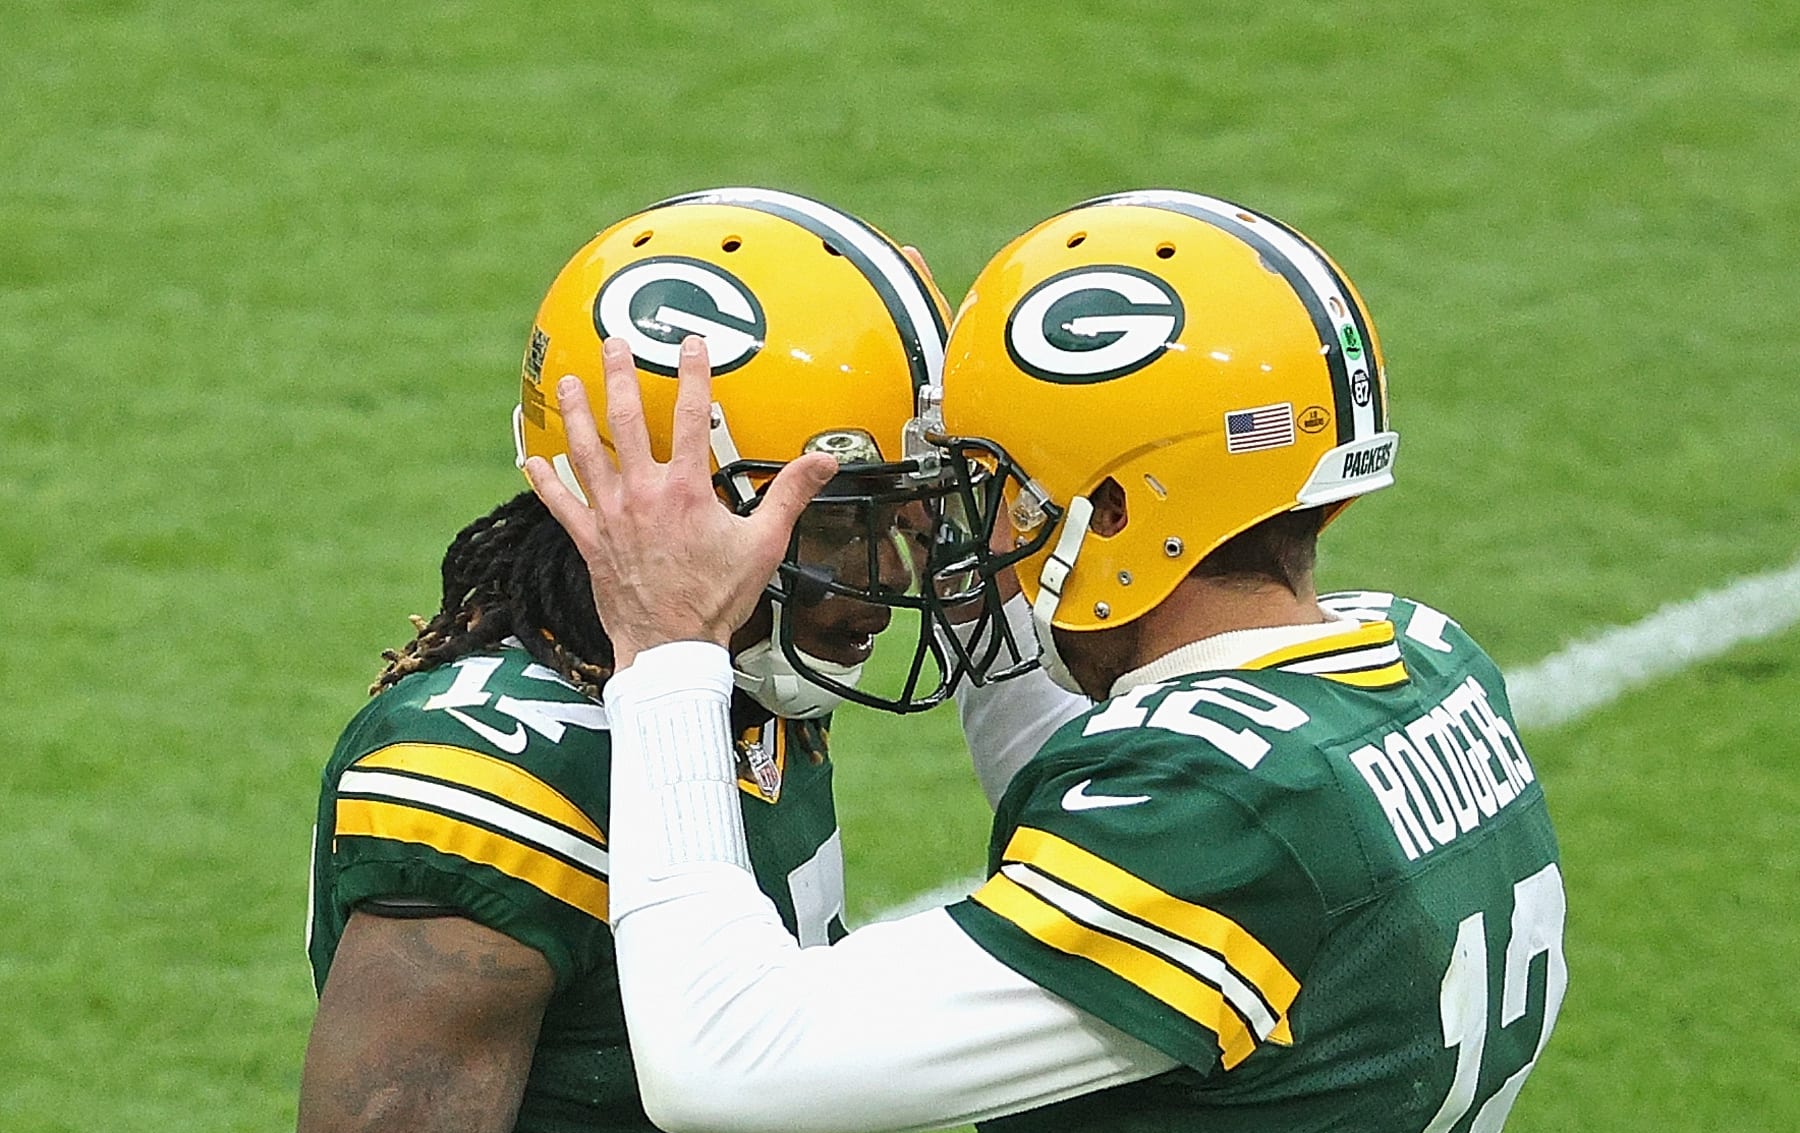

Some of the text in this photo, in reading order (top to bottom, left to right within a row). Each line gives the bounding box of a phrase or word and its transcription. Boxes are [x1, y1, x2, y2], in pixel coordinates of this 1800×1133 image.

[1011, 272, 1176, 375] G
[1354, 380, 1369, 403] 87
[1342, 441, 1393, 479] PACKERS
[1082, 676, 1311, 770] 12
[1348, 674, 1536, 862] RODGERS
